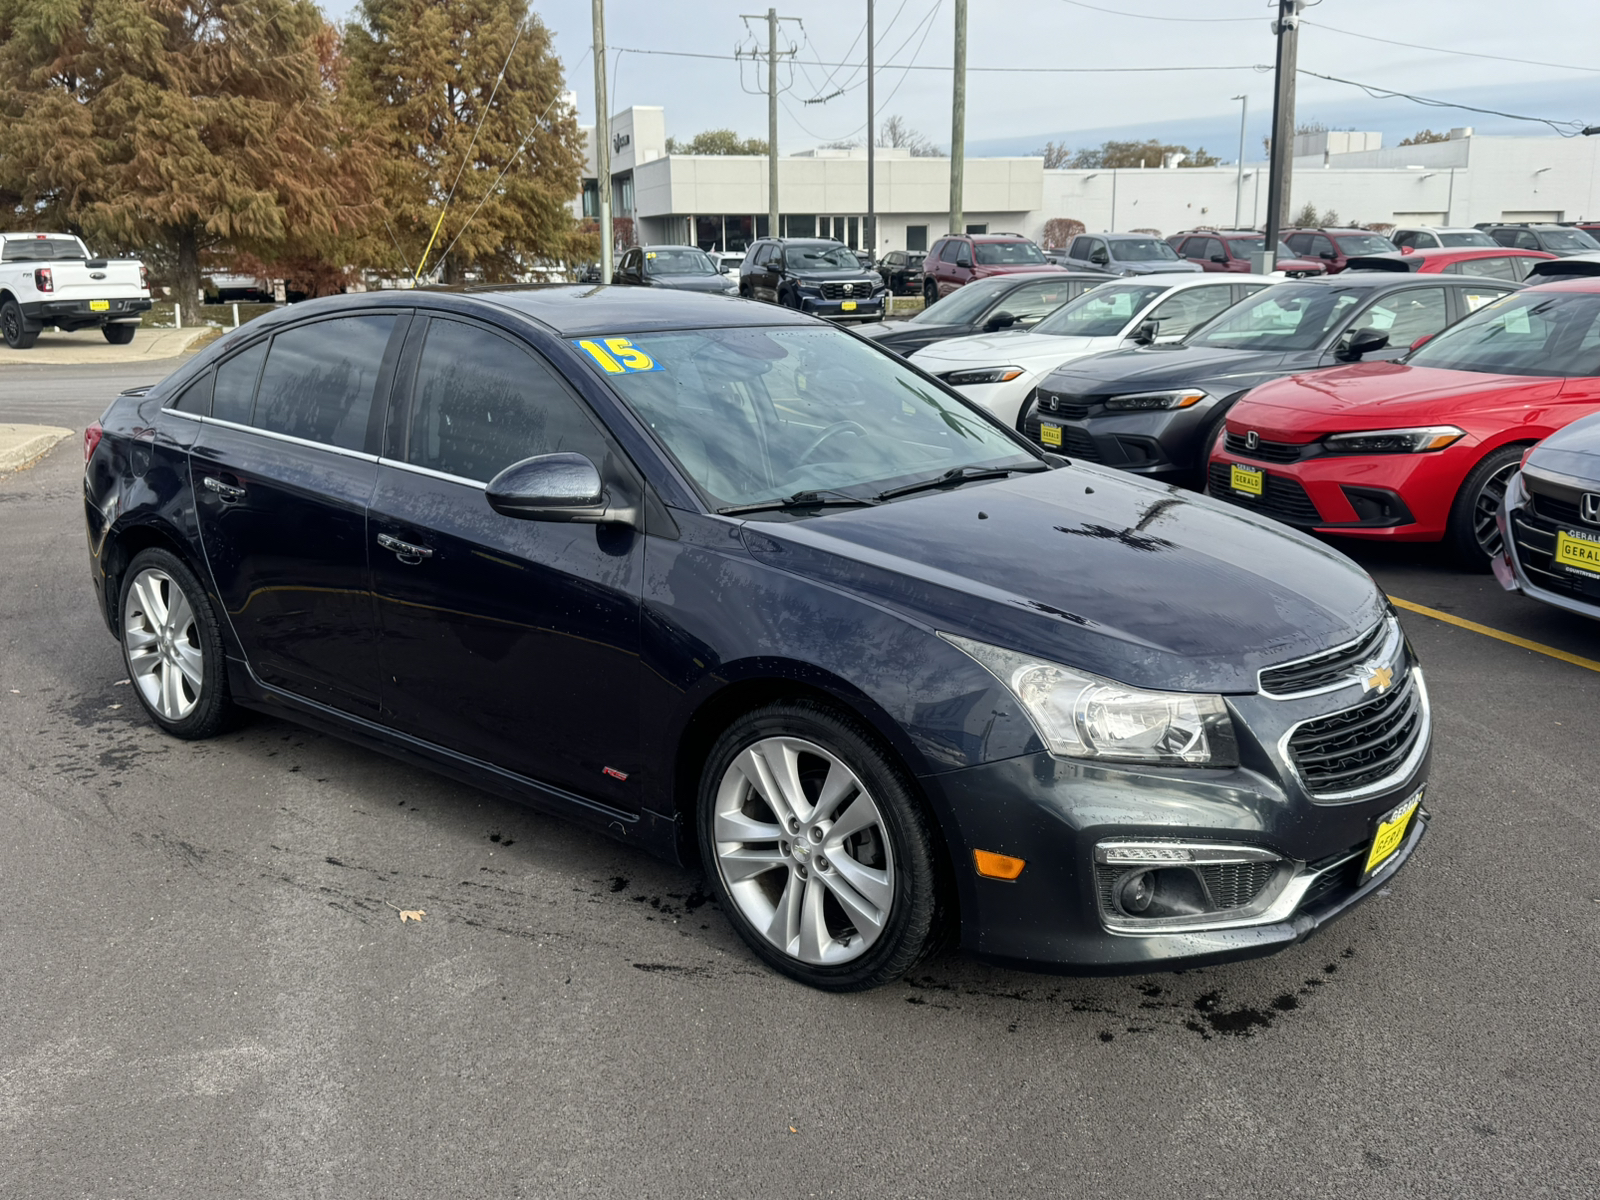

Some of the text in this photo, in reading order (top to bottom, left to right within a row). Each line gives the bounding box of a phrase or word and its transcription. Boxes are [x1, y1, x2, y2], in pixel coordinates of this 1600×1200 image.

[579, 338, 654, 373] 15
[1043, 430, 1060, 440] GERALD
[1237, 463, 1256, 473] GERALD
[1236, 474, 1259, 487] GERALD
